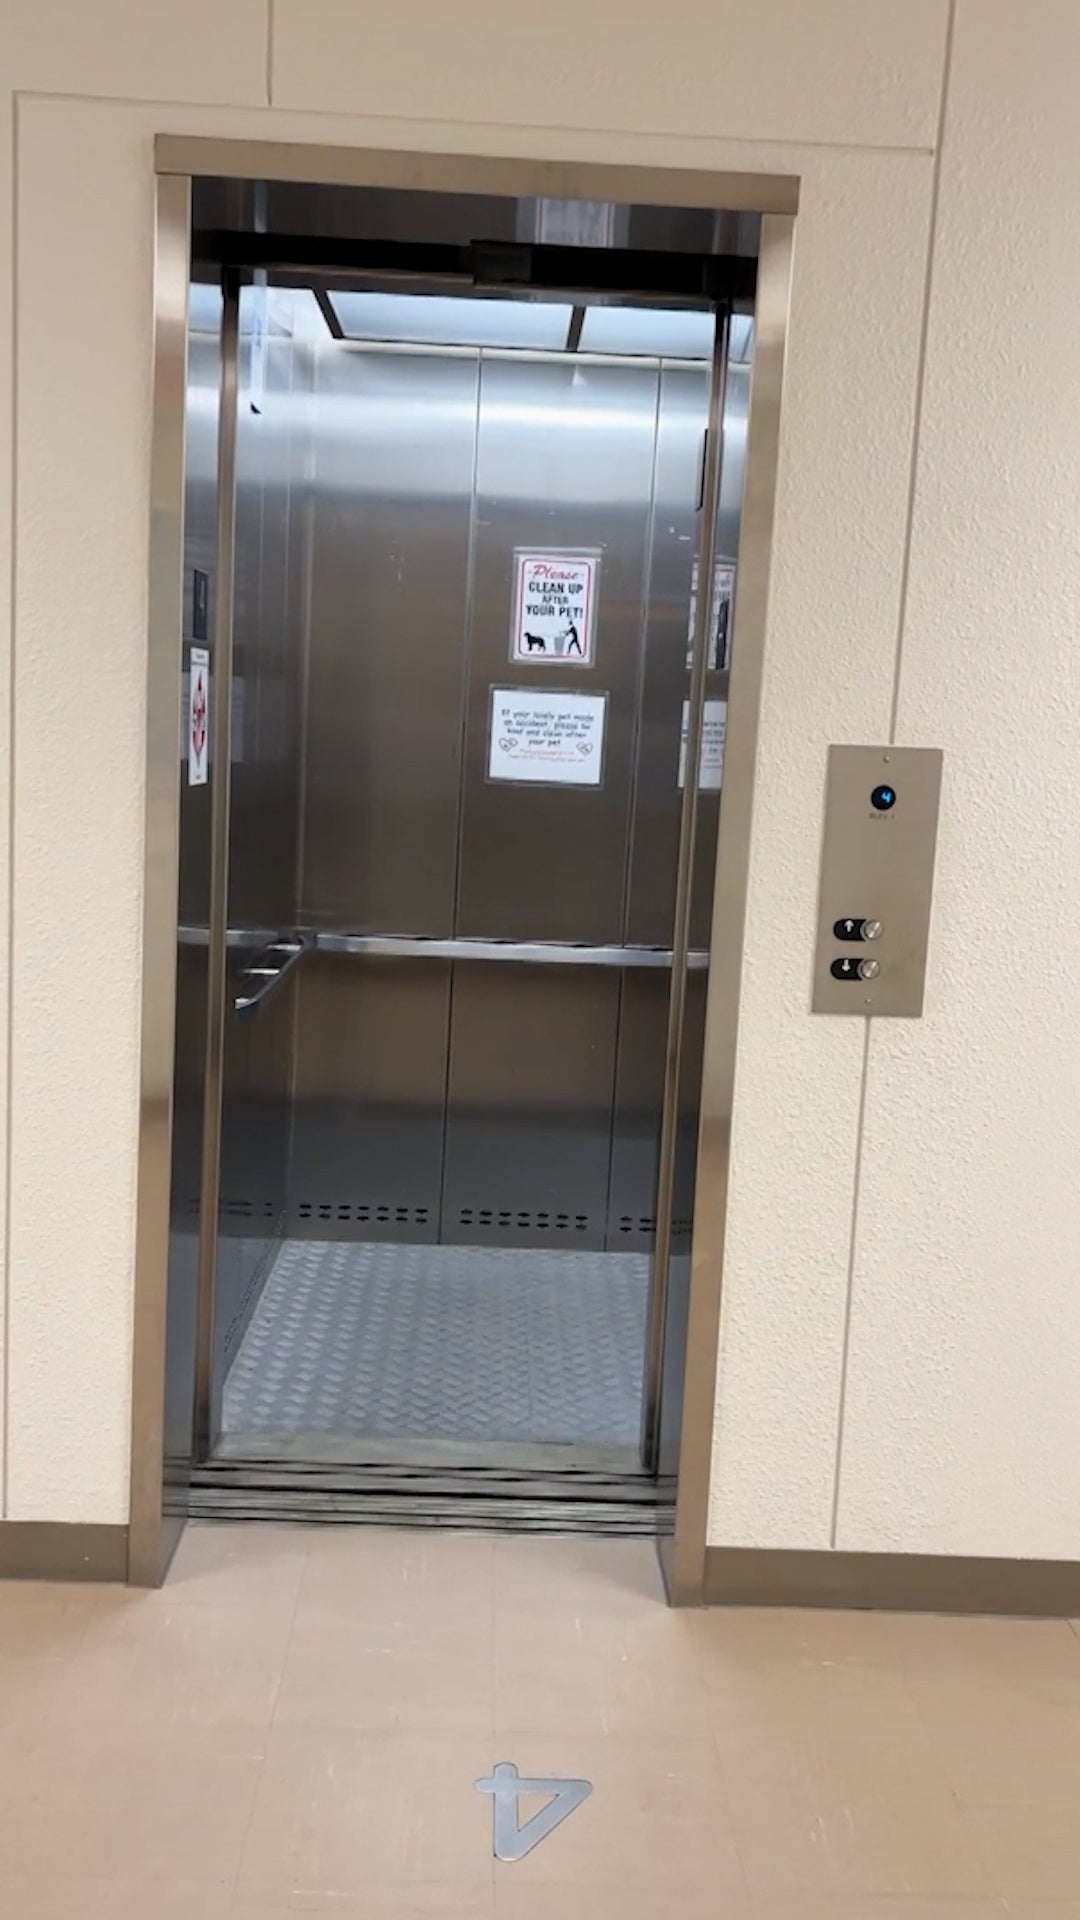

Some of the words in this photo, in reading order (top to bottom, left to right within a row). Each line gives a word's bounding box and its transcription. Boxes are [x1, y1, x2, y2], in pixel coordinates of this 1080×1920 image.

[533, 564, 579, 580] Please
[528, 581, 564, 594] CLEAN
[568, 583, 584, 594] UP
[541, 596, 569, 604] AFTER
[526, 605, 555, 616] YOUR
[559, 607, 584, 619] PET!
[513, 711, 530, 719] your
[543, 729, 563, 738] clean
[547, 740, 561, 748] pet
[881, 791, 892, 803] 4
[473, 1761, 593, 1862] 4
